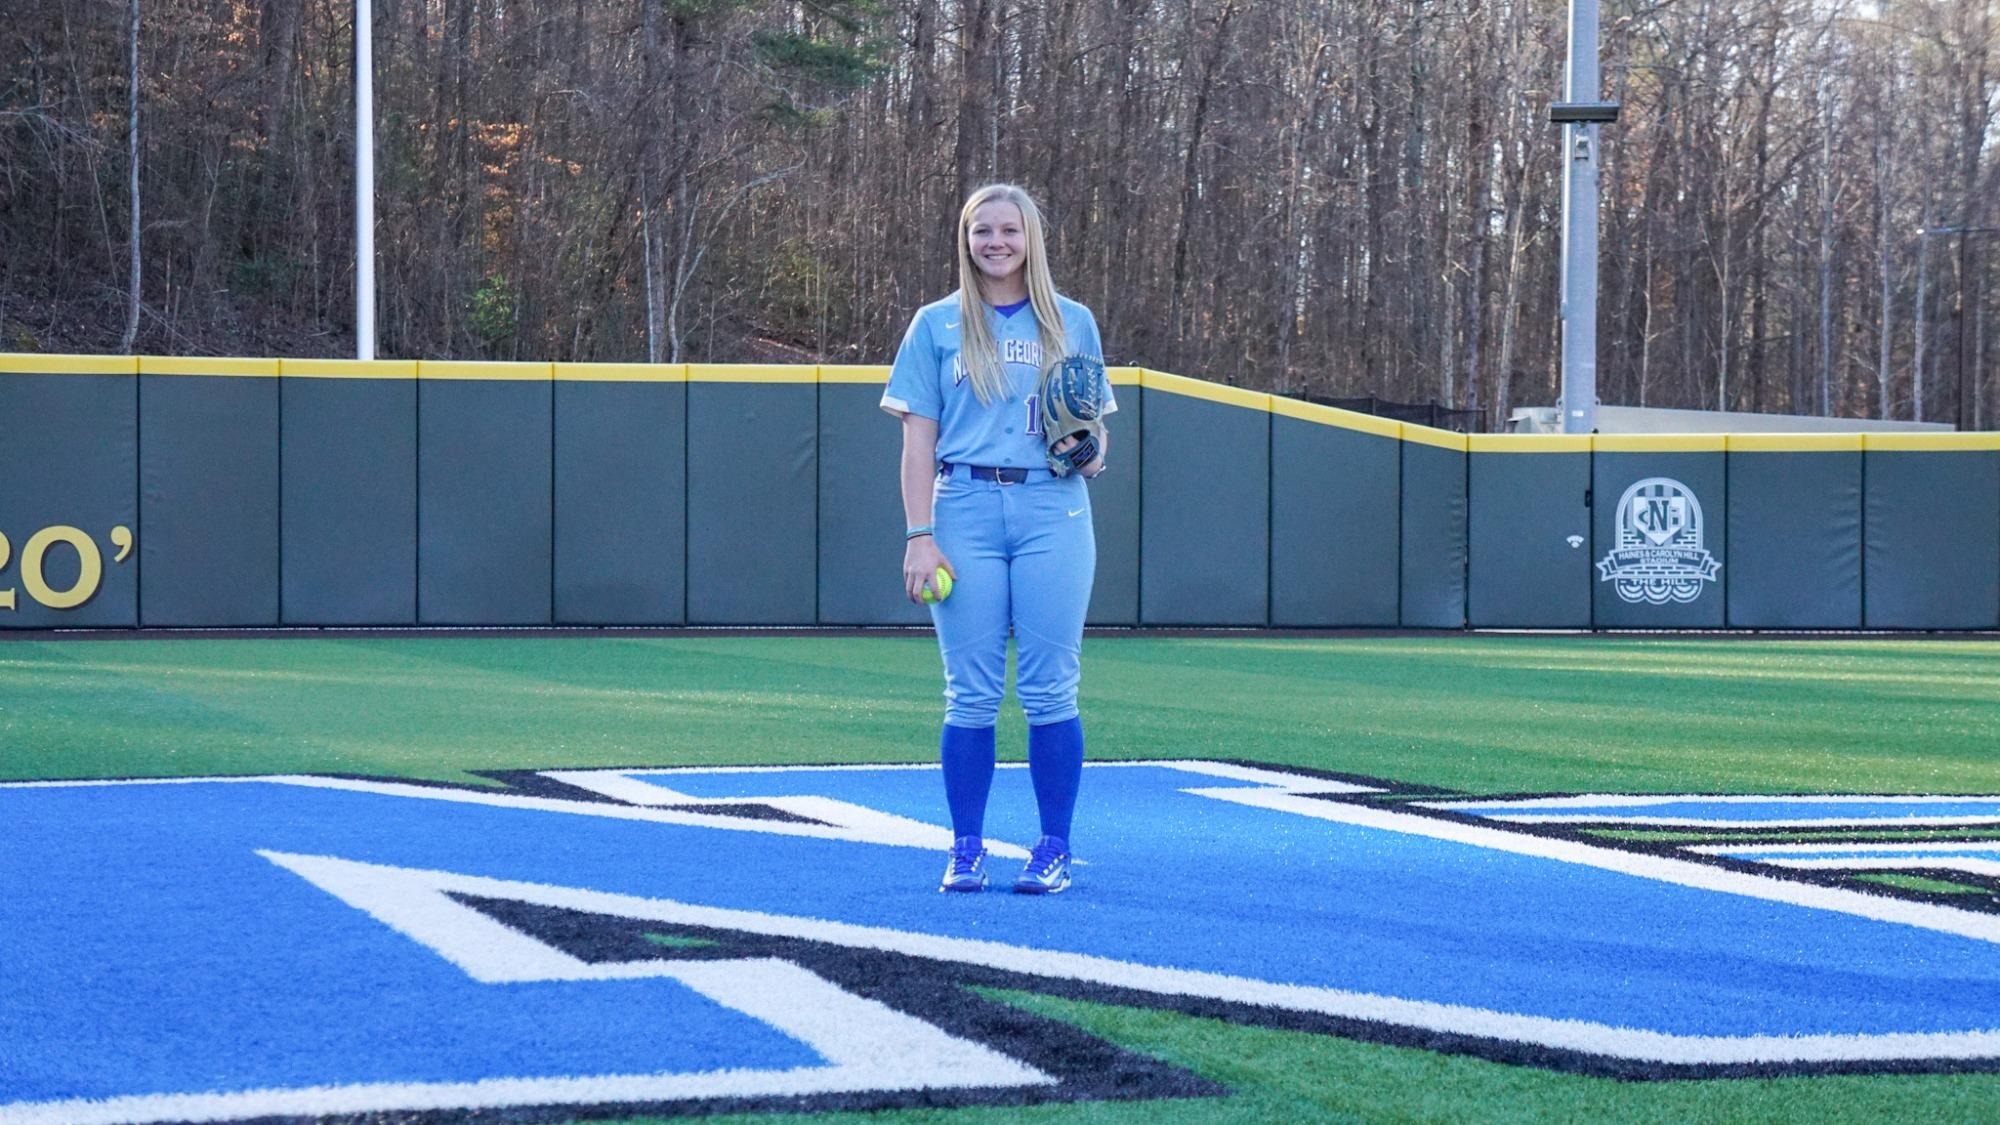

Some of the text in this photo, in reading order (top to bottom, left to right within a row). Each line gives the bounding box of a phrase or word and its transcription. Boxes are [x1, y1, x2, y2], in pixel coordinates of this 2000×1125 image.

[1004, 340, 1042, 369] GEOR
[1618, 550, 1643, 560] HAINES
[1651, 550, 1683, 559] CAROLYN
[1683, 551, 1700, 561] HILL
[1631, 577, 1688, 586] THE HILL
